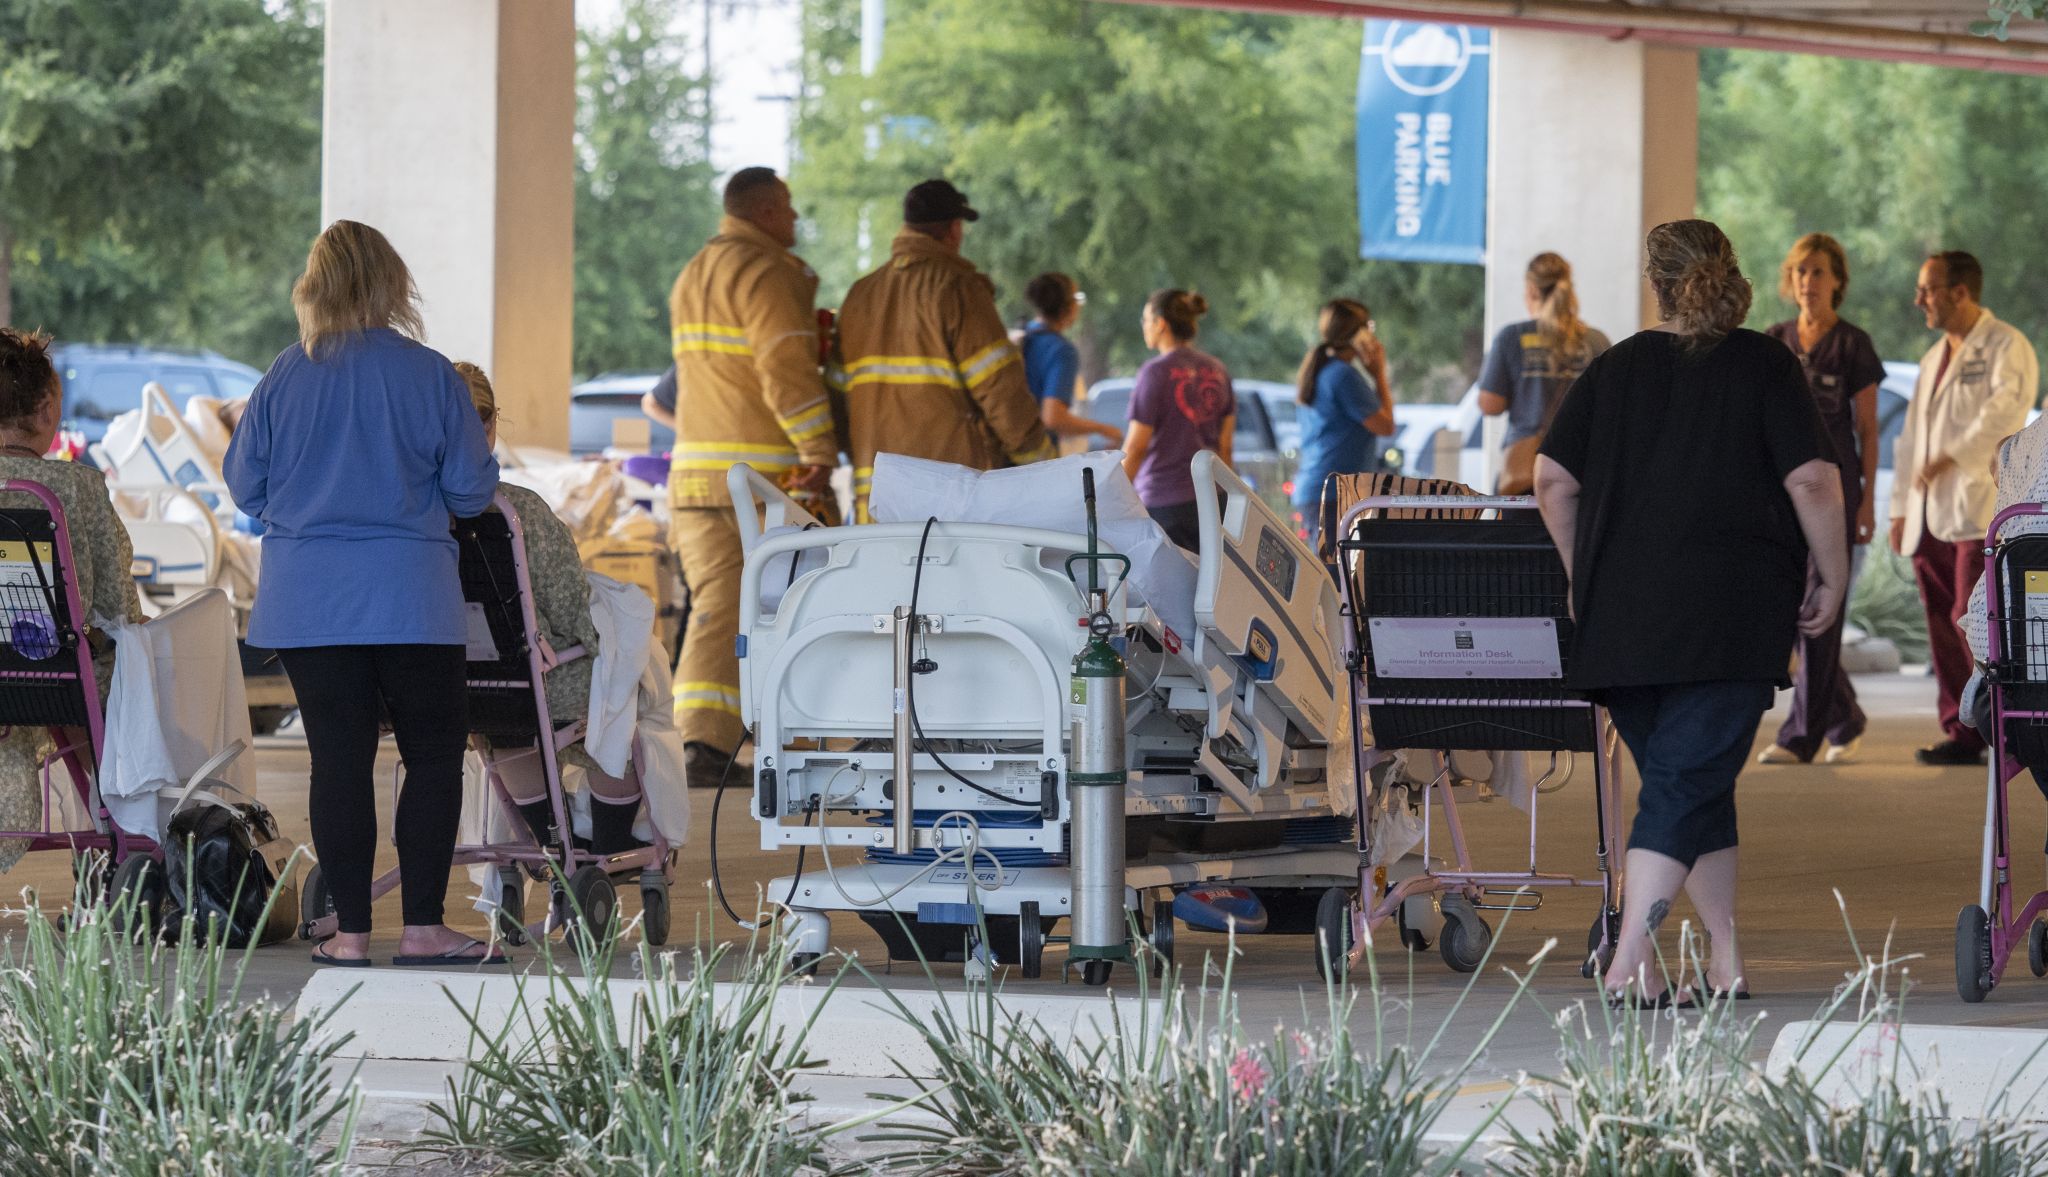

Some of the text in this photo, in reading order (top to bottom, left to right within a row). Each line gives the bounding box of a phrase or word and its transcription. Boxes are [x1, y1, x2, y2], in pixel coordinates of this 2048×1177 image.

[1426, 112, 1452, 186] BLUE
[1395, 112, 1421, 237] PARKING
[1256, 638, 1266, 654] PULL
[1419, 650, 1513, 658] Information Desk
[952, 872, 996, 881] STER
